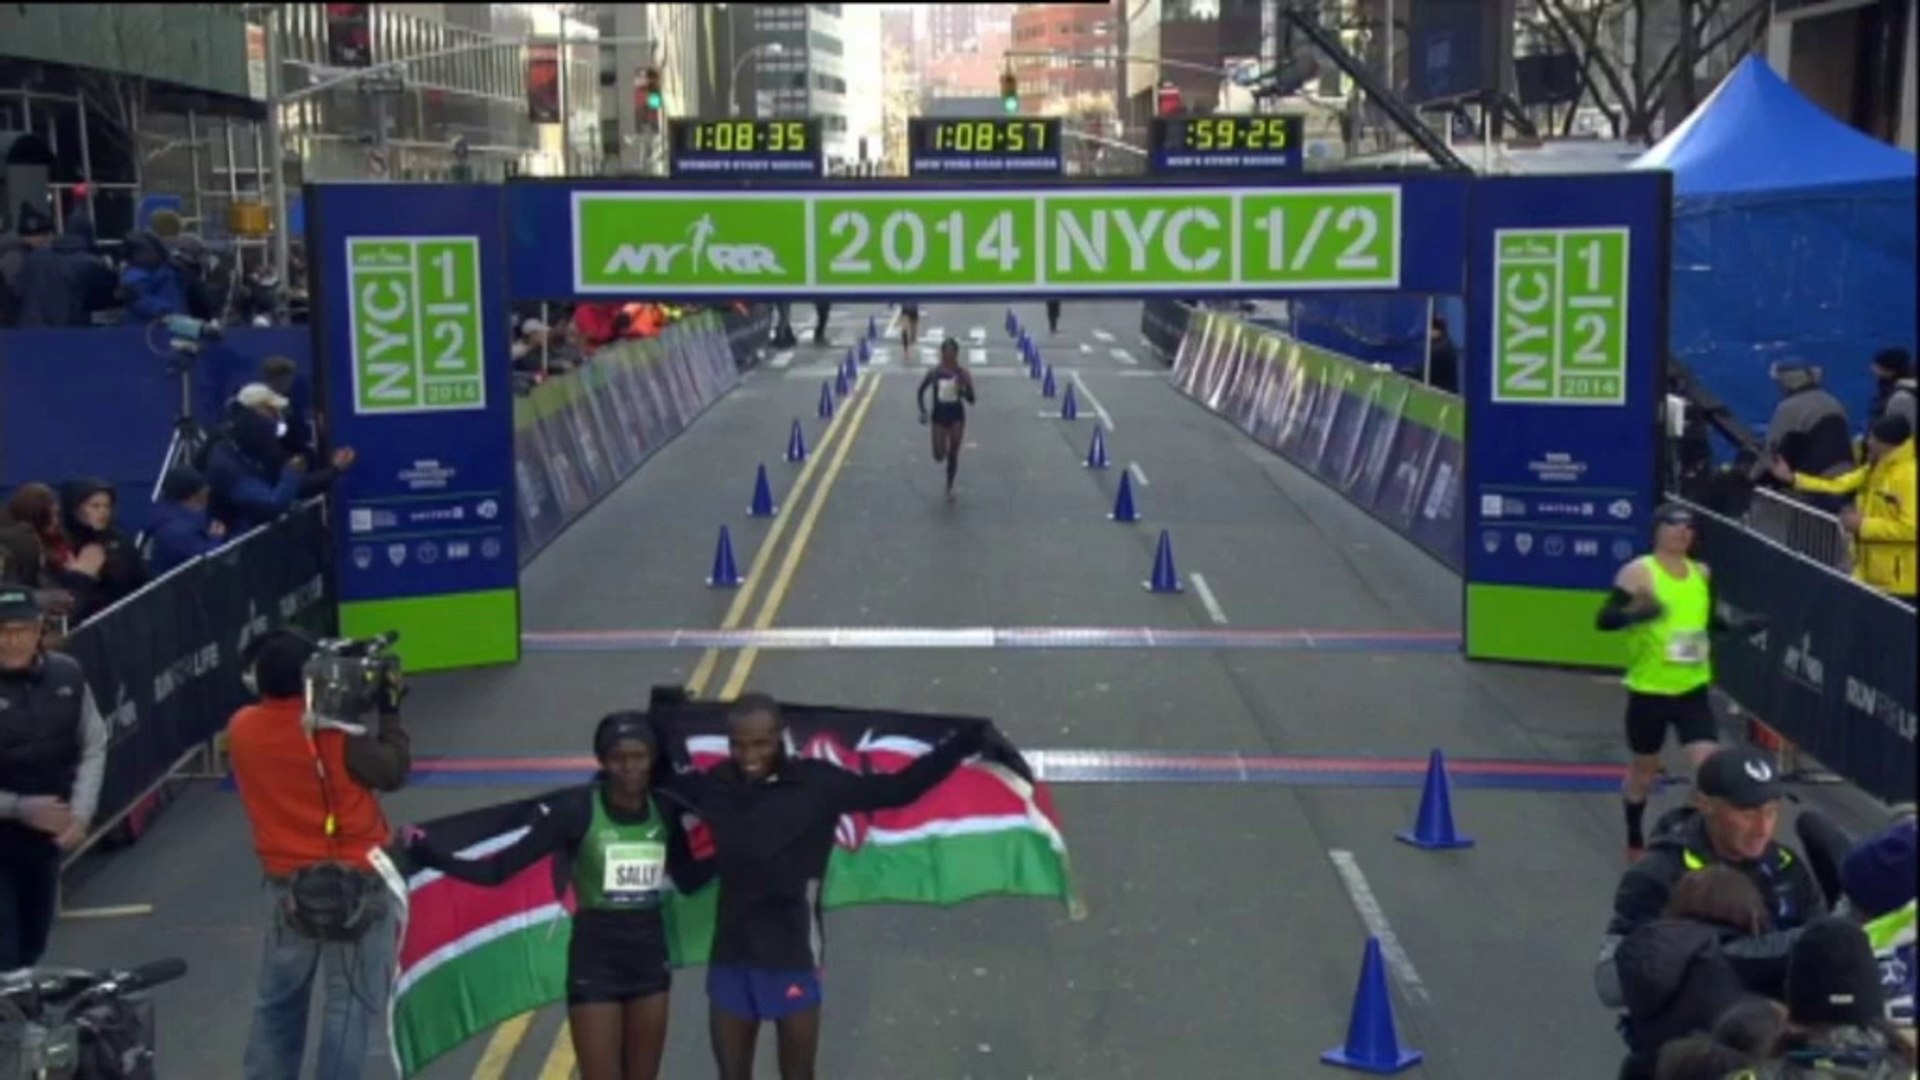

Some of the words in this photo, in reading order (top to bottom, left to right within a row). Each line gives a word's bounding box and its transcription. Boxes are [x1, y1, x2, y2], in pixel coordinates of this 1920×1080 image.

[829, 209, 1021, 273] 2014
[1055, 207, 1221, 272] NYC
[1254, 206, 1378, 271] 1/2
[362, 280, 412, 399] NYC
[1504, 271, 1550, 391] NYC
[1564, 379, 1617, 396] 2014
[615, 864, 658, 887] SALLY
